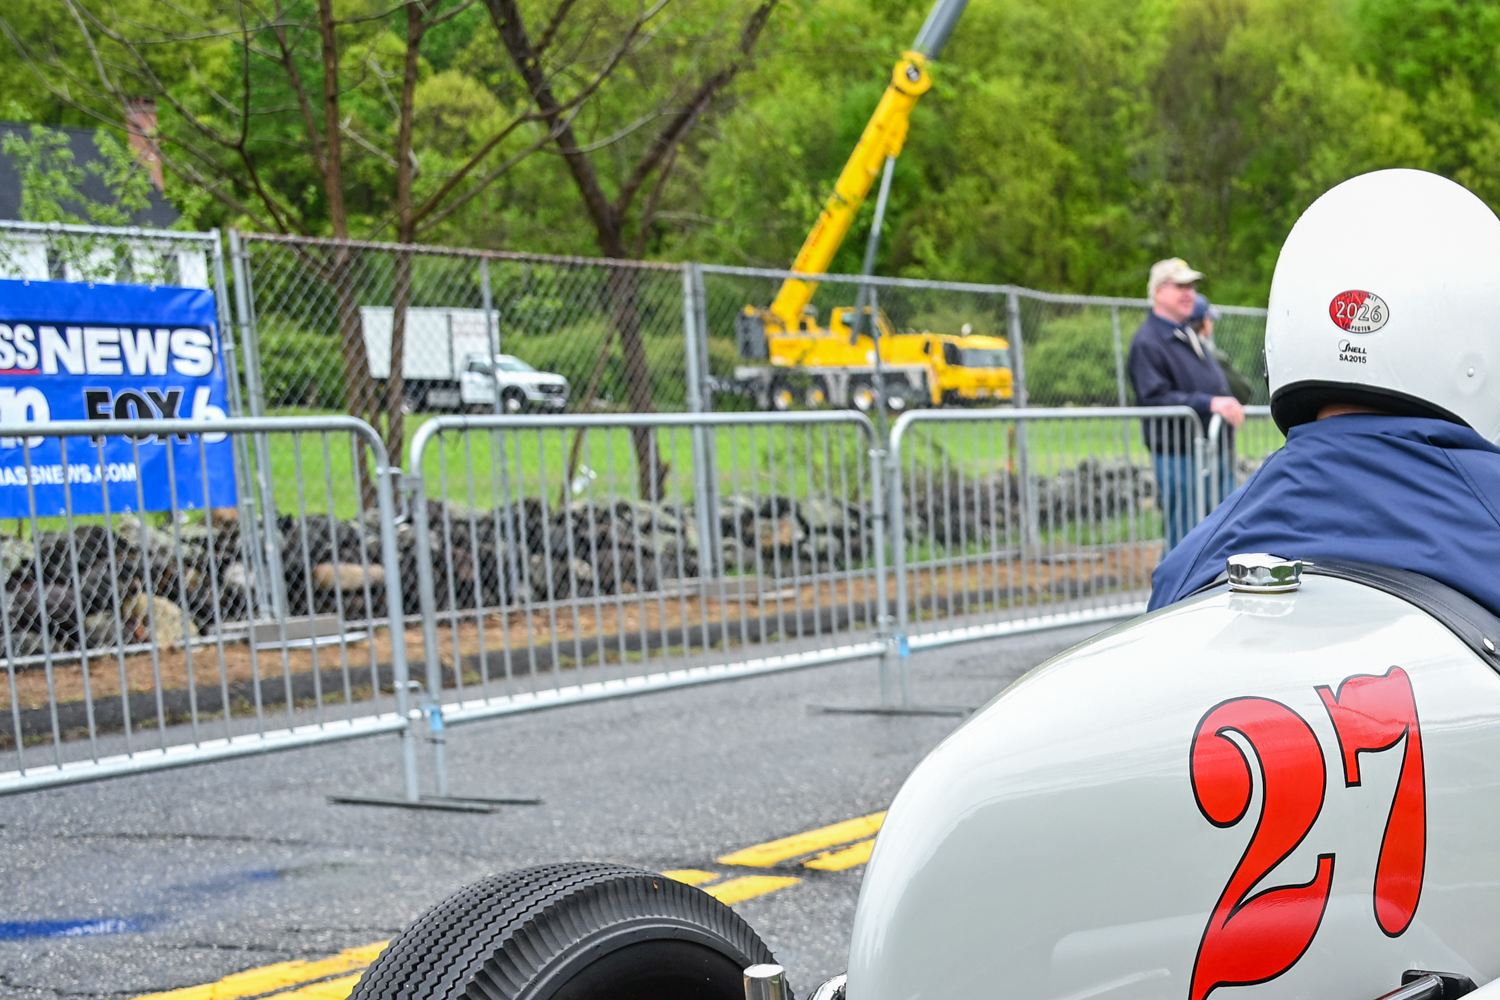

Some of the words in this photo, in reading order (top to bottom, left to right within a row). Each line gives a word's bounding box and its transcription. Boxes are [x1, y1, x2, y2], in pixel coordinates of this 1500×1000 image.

[1336, 300, 1382, 323] 2026
[1340, 341, 1367, 354] SNELL
[1339, 353, 1367, 364] SA2015
[0, 462, 137, 486] ASSNEWS.COM
